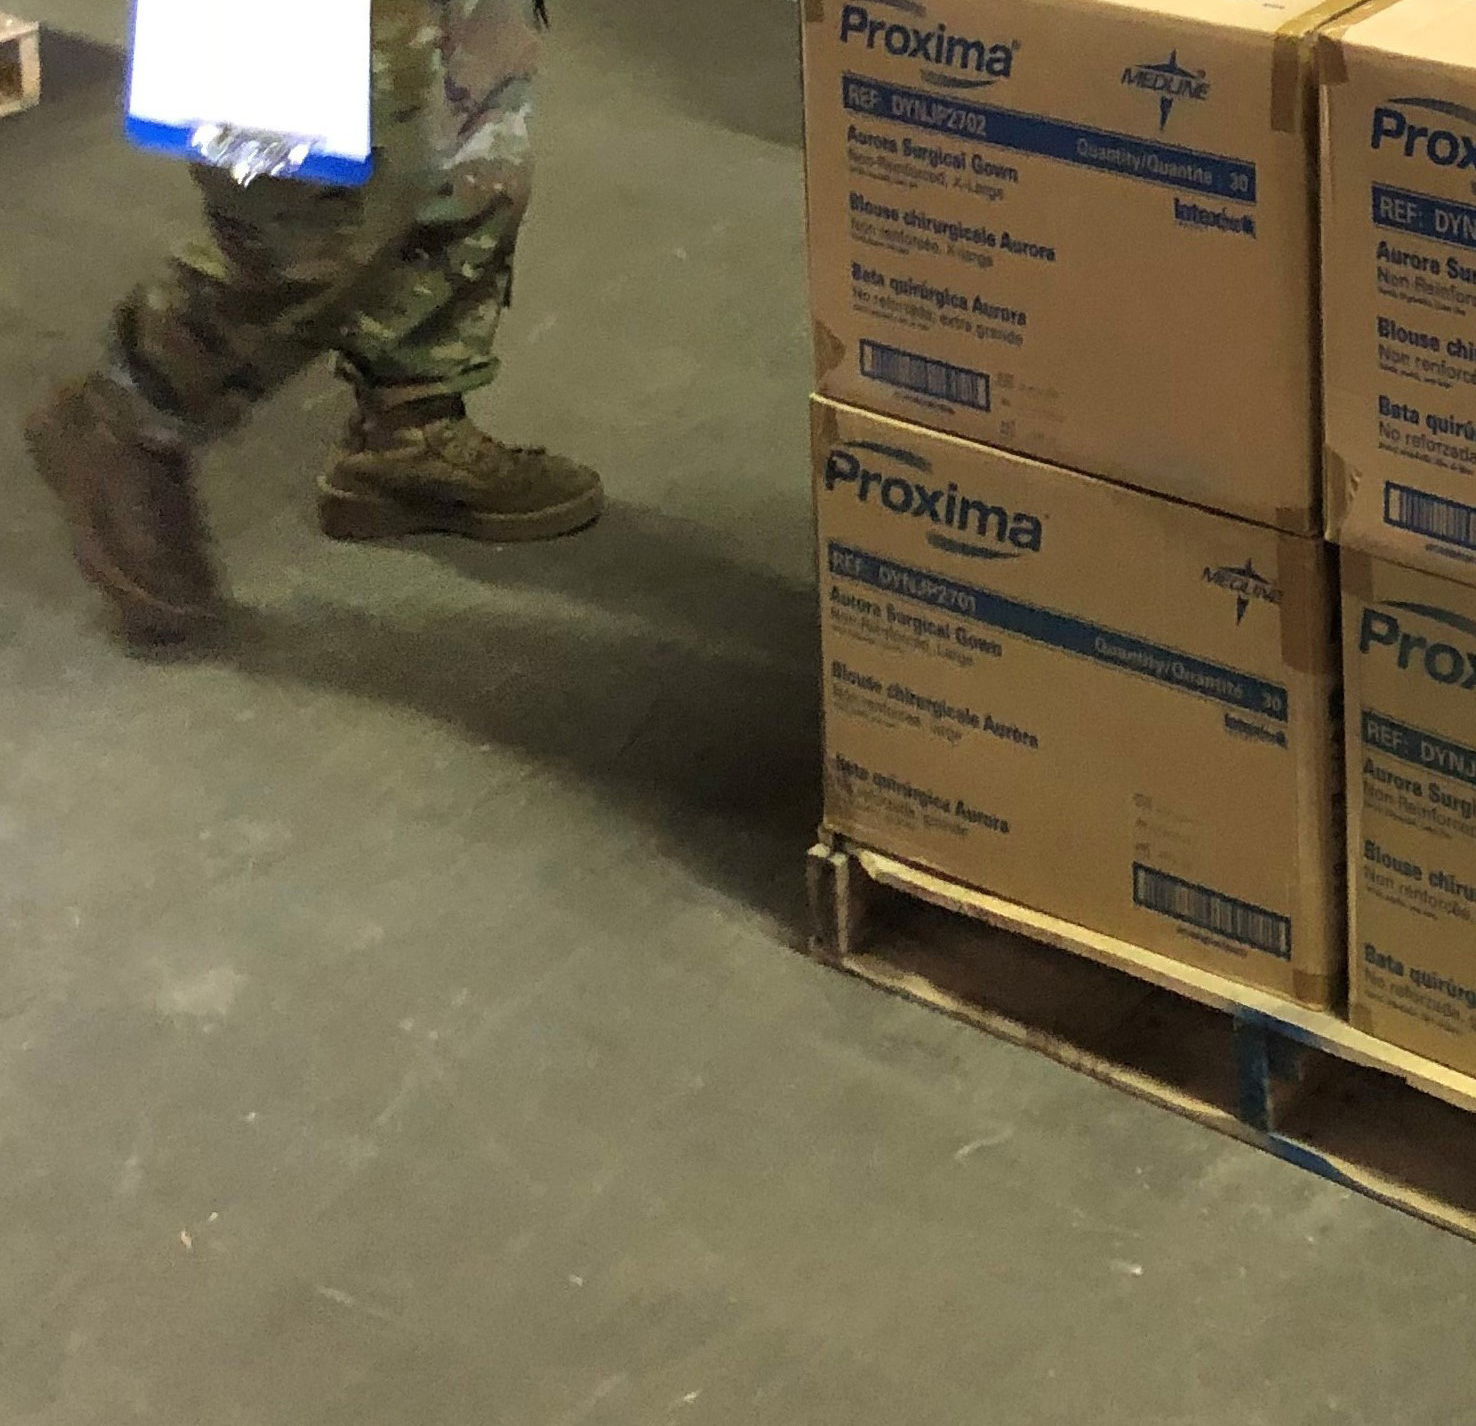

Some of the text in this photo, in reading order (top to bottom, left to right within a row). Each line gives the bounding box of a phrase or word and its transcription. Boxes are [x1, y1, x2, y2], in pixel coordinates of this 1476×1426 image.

[839, 2, 1014, 80] Proxima
[1120, 64, 1210, 103] MEDLINE
[847, 125, 1018, 184] Aurora Surgical Gown
[849, 192, 899, 222] Blouse
[999, 231, 1056, 263] Aurora
[1375, 239, 1439, 277] Aurora
[971, 293, 1027, 327] Aurora
[1376, 314, 1439, 352] Blouse
[1377, 343, 1410, 369] Non
[1378, 394, 1419, 426] Bata
[1378, 420, 1400, 442] No
[824, 444, 1043, 556] Proxima
[1362, 755, 1422, 797] Aurora
[1363, 838, 1422, 881] Blouse
[1364, 942, 1404, 979] Bata
